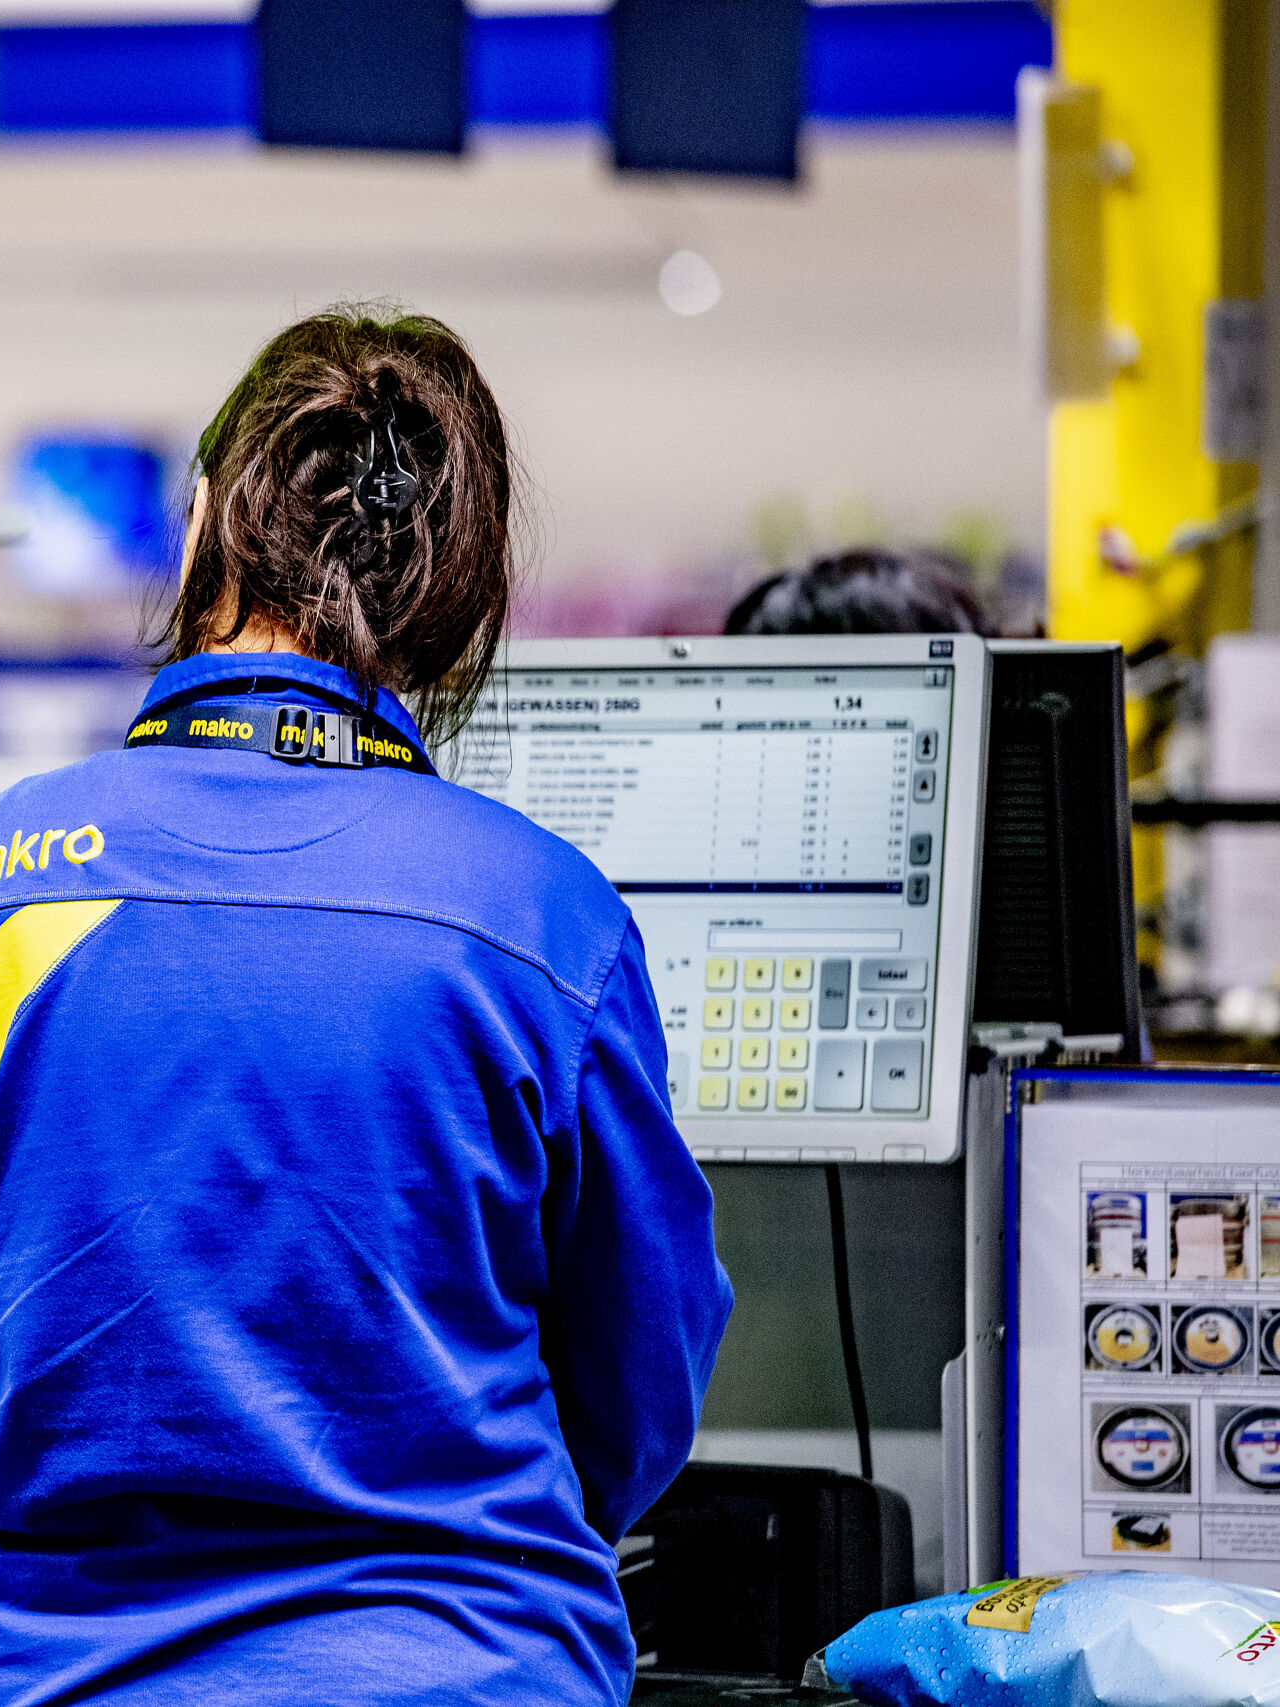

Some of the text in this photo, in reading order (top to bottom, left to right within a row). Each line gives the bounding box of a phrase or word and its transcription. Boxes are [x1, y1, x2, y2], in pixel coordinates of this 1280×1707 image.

[714, 697, 722, 711] 1
[833, 696, 863, 712] 1,34
[189, 717, 254, 740] makro
[356, 735, 413, 763] makro
